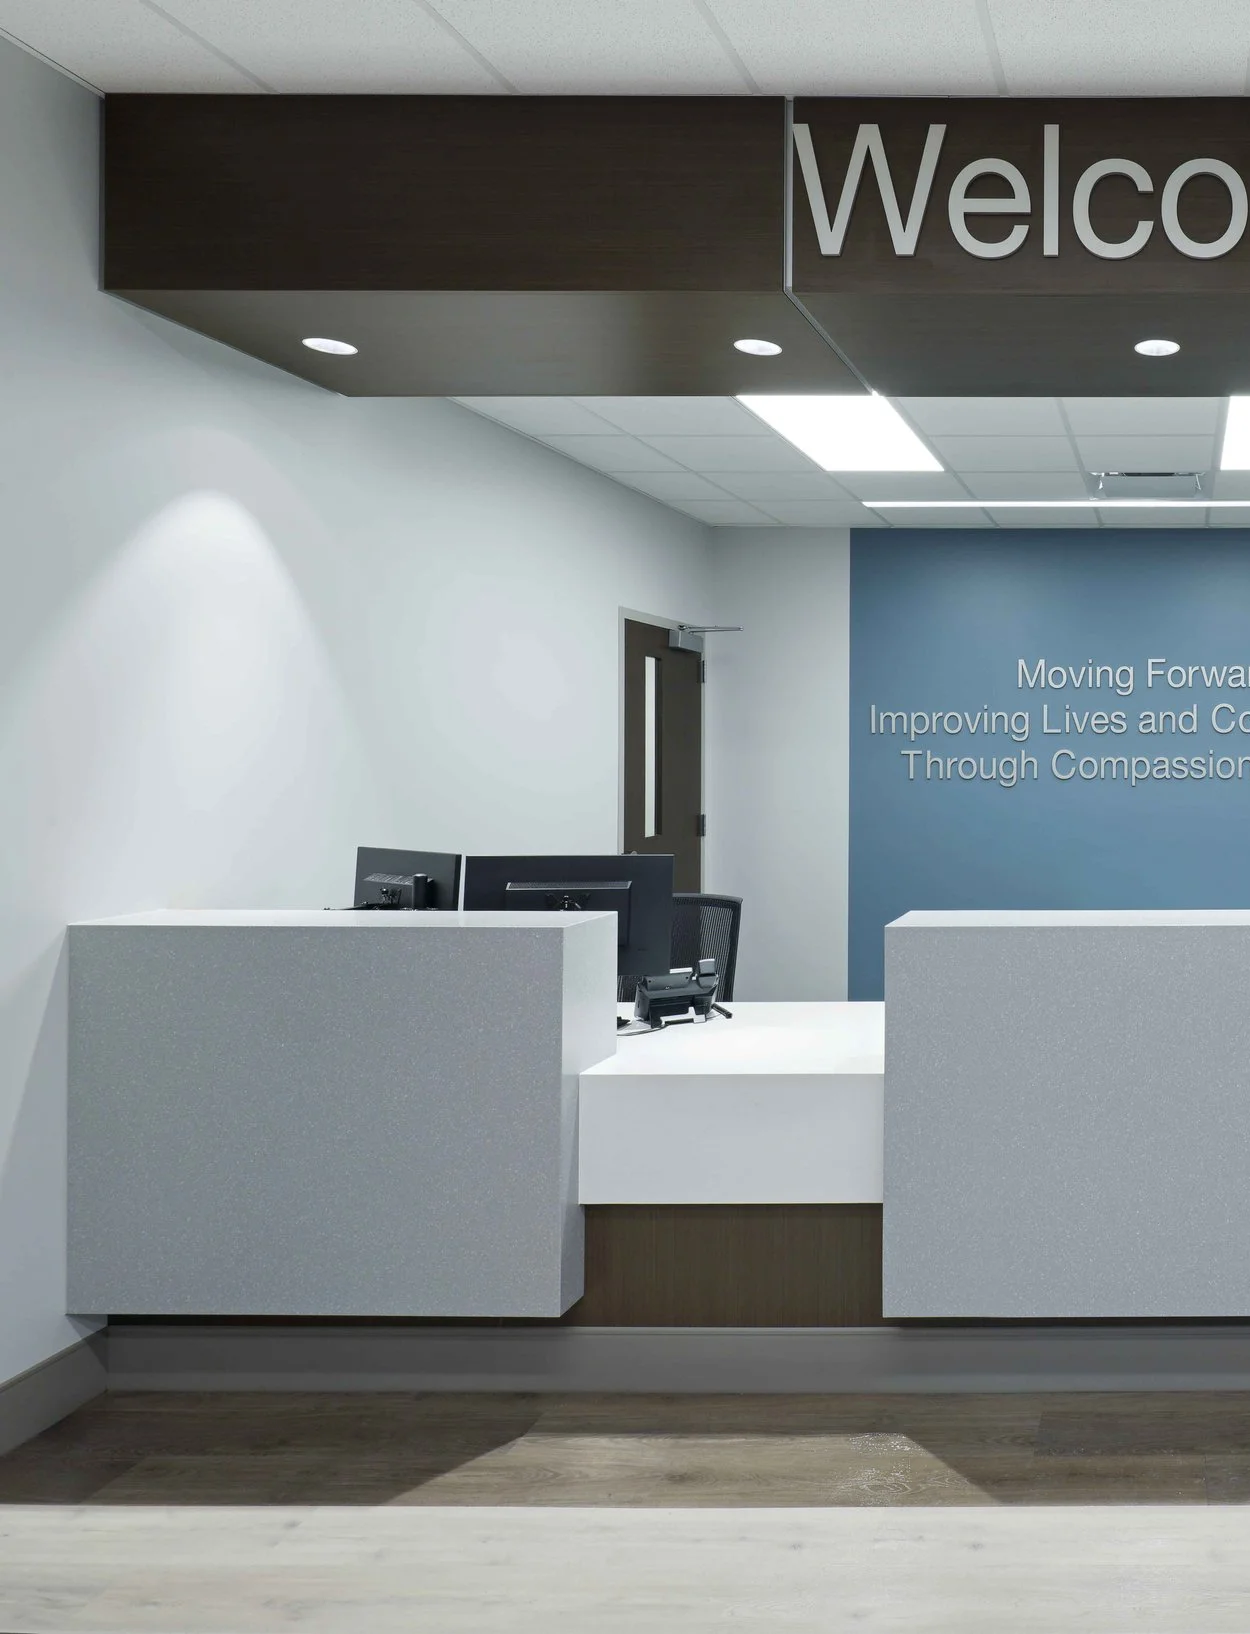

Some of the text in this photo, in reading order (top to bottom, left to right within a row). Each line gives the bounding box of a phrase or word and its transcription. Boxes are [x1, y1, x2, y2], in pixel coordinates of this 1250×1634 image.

[1017, 658, 1134, 696] Moving
[871, 704, 1030, 742] Improving
[1043, 704, 1127, 734] Lives
[1138, 703, 1198, 734] and
[900, 749, 1038, 787] Through
